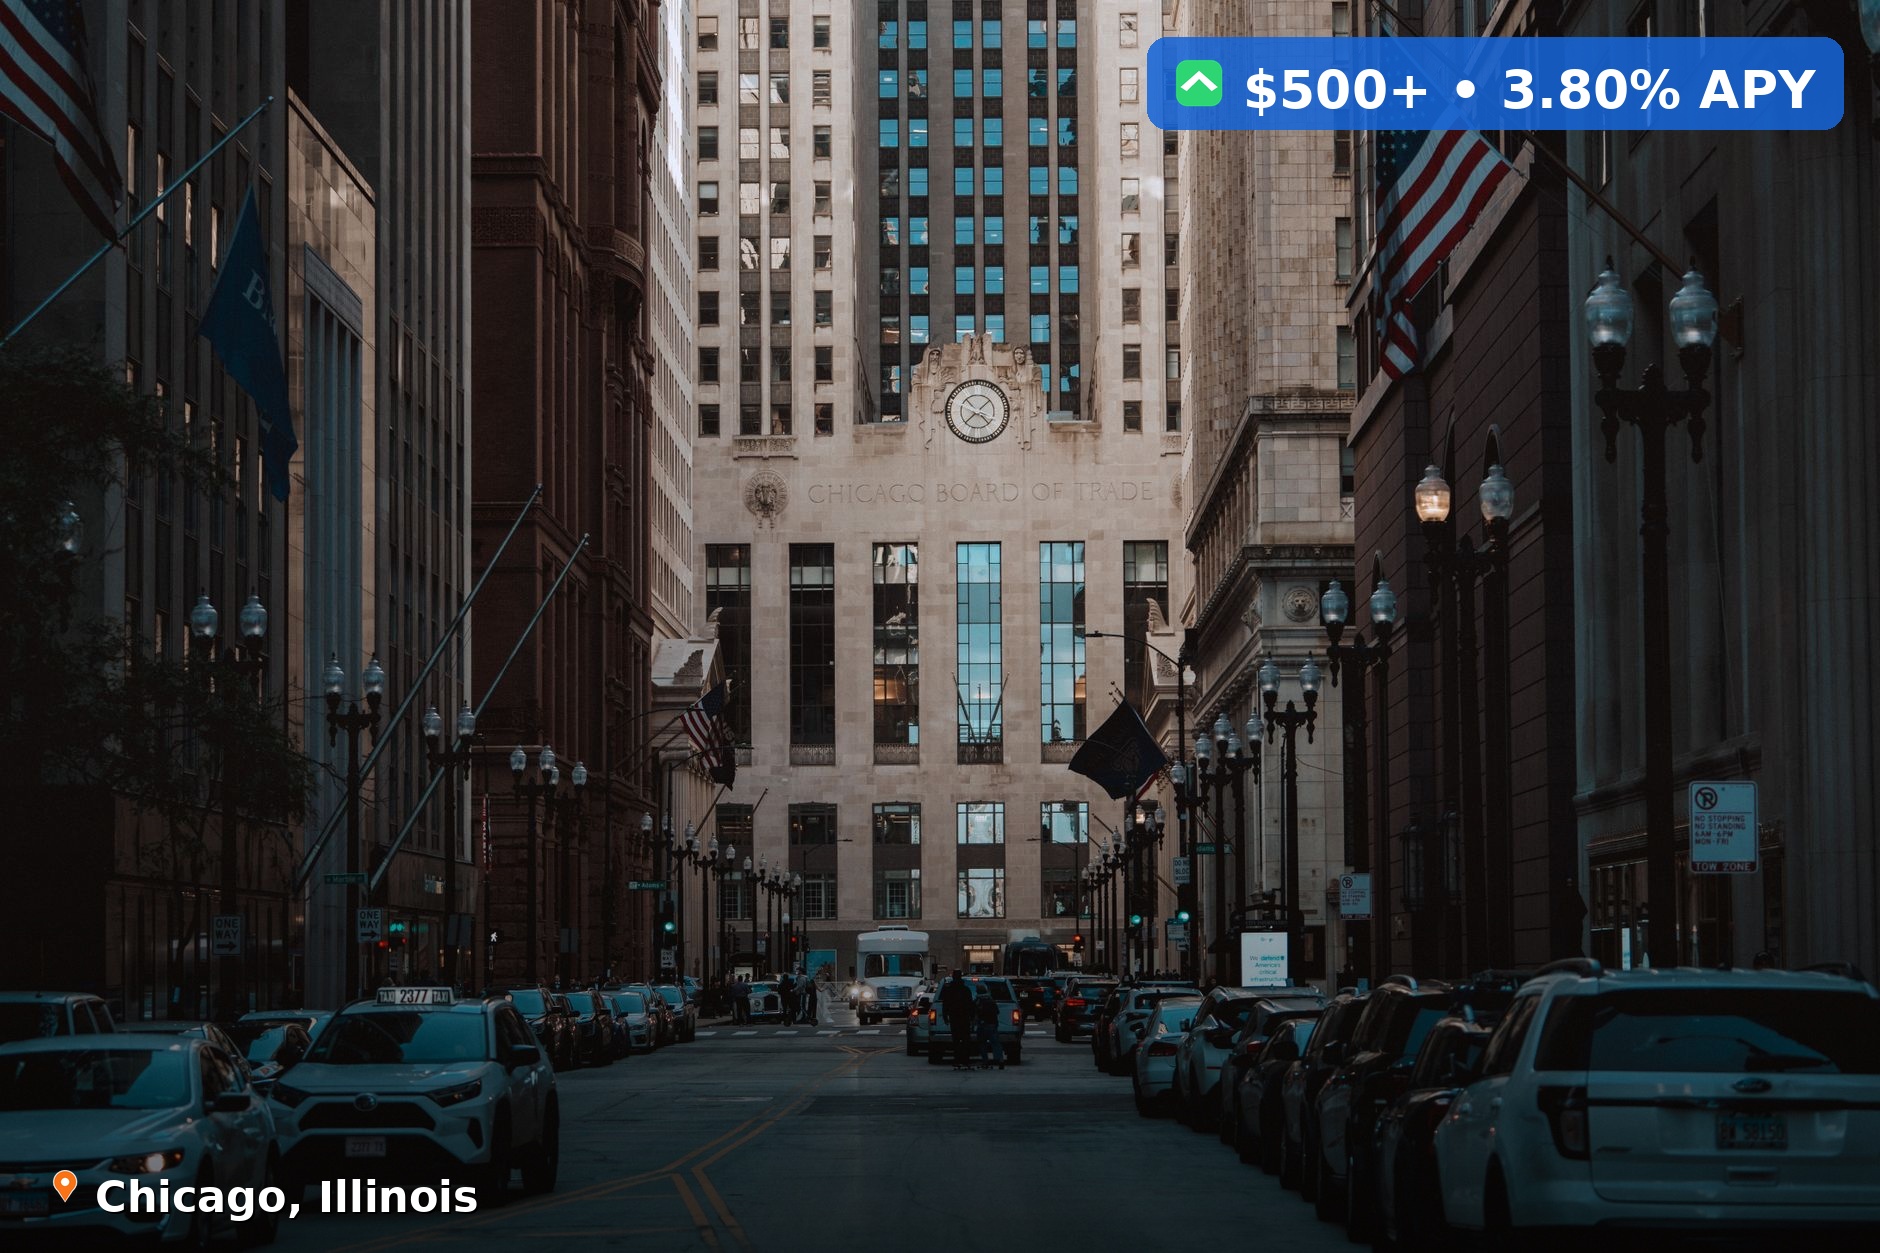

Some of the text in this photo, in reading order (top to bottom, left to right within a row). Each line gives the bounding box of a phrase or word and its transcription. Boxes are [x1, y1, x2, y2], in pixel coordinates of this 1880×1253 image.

[808, 481, 1154, 504] CHICAGO BOARD OF TRADE
[1696, 862, 1751, 871] TOW ZONE
[360, 911, 379, 919] ONE
[216, 919, 238, 928] ONE
[360, 920, 380, 928] WAY
[216, 929, 239, 940] WAY
[379, 989, 449, 1003] TAXI 2377 TAXI
